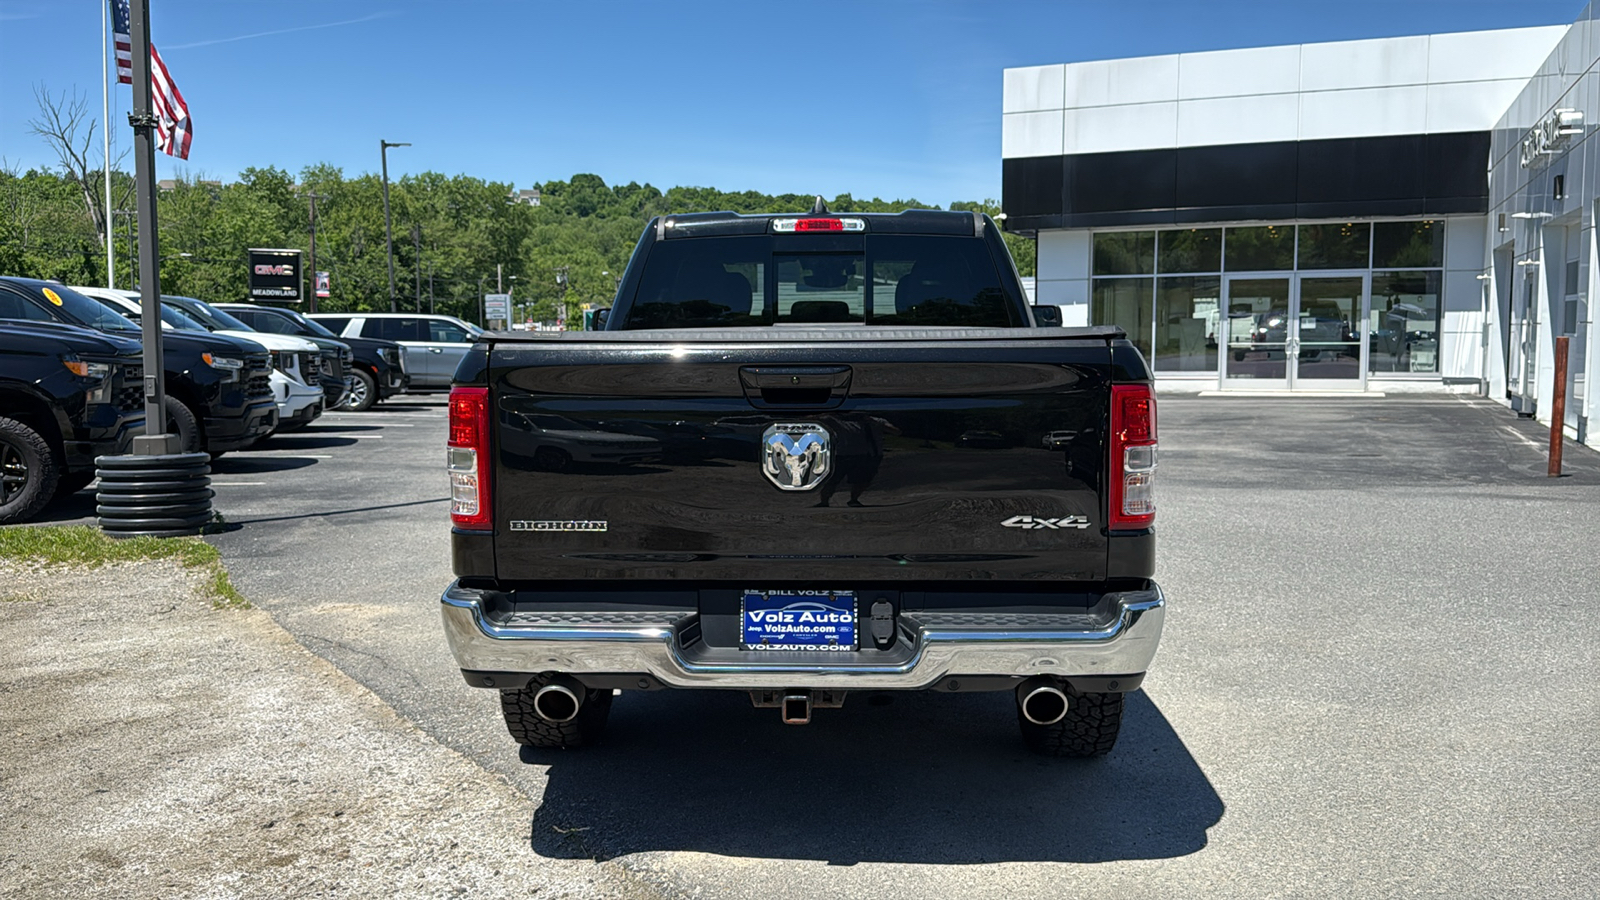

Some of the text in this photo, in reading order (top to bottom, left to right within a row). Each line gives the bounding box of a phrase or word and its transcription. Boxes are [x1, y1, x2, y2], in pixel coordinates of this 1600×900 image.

[254, 264, 294, 276] GMC
[252, 288, 298, 297] MEADOWLAND
[509, 520, 608, 532] BIGHORN
[748, 611, 853, 623] Volz Auto
[764, 624, 836, 633] VolzAuto.com
